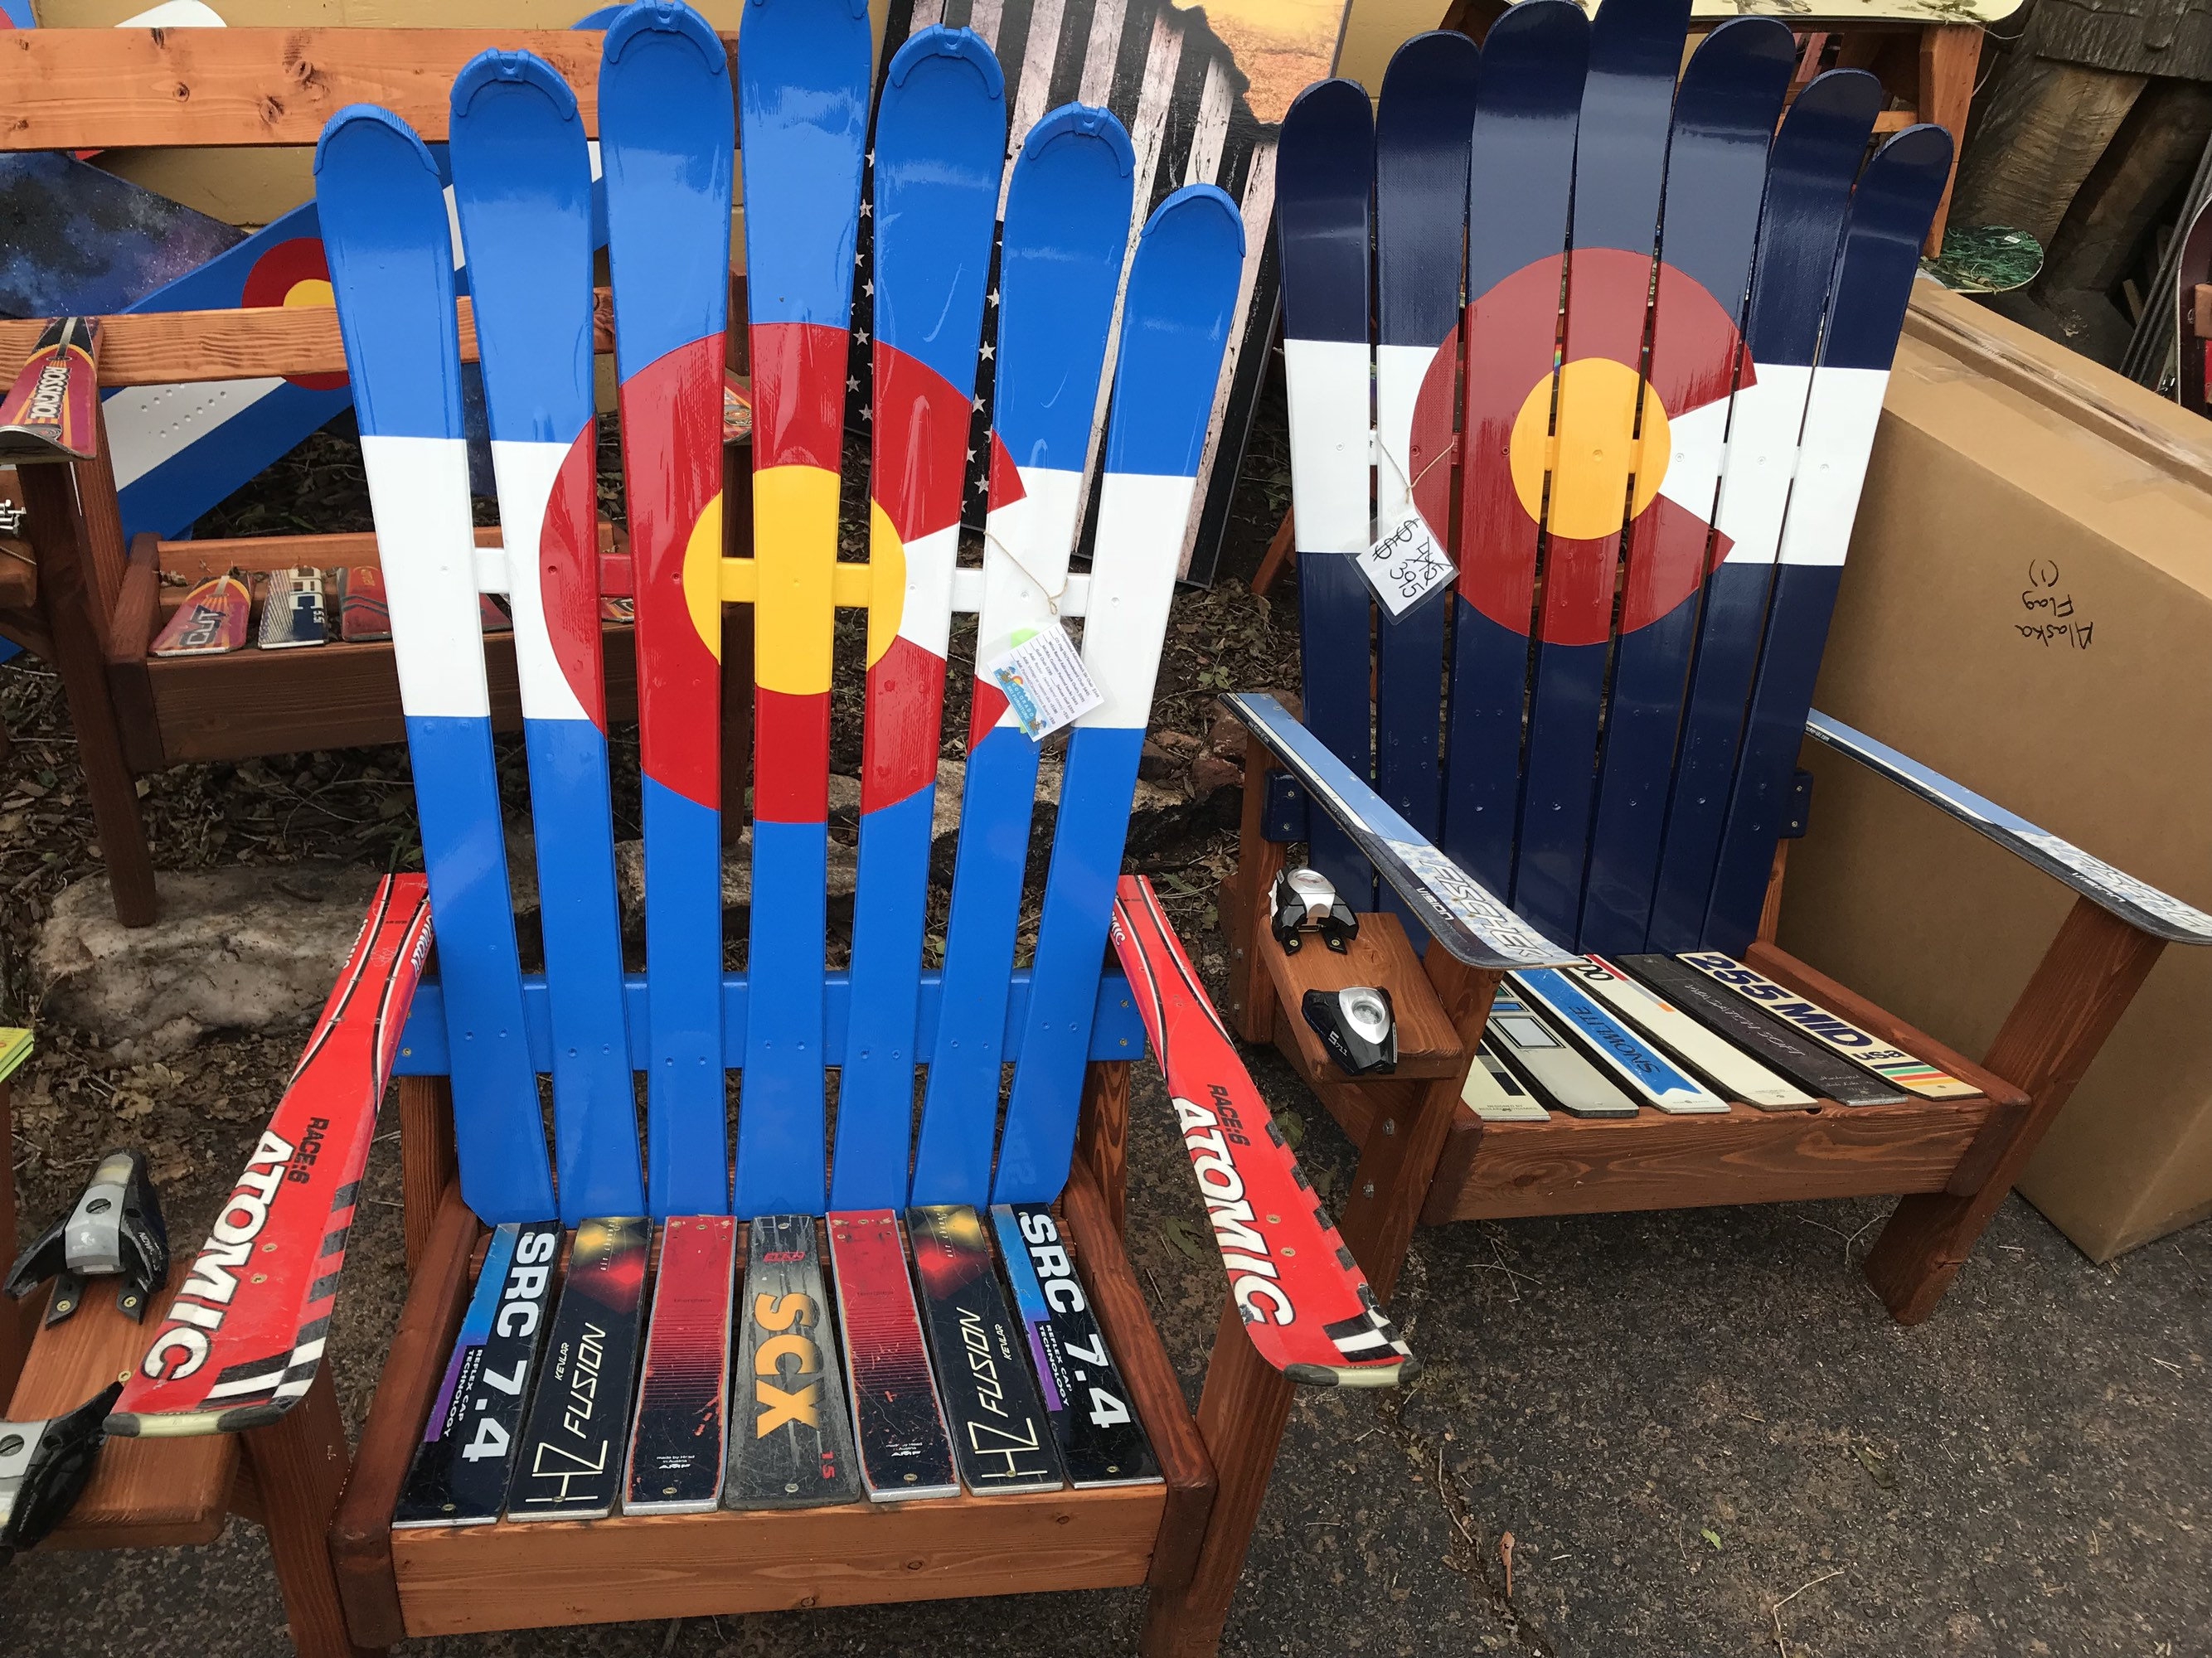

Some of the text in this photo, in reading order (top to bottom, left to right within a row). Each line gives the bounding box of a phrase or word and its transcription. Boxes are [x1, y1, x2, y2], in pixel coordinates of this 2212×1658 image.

[32, 366, 68, 419] ROSSIGNOL
[1390, 561, 1425, 598] 395
[2021, 590, 2074, 618] Flag
[182, 605, 224, 646] CUT
[2015, 621, 2093, 650] Alaska
[1006, 685, 1014, 694] SKI
[1011, 693, 1030, 720] FURNITURE
[1011, 682, 1034, 717] COLORADO
[1416, 887, 1455, 922] VISION
[1419, 860, 1554, 957] FISCHER
[2053, 847, 2212, 937] FISCHE
[1692, 955, 1874, 1048] 255 MID
[1570, 1006, 1661, 1074] SNOWLITE
[1855, 1050, 1907, 1062] usa
[1206, 1083, 1251, 1148] RACE:6
[287, 1116, 330, 1185] RACE:6
[1171, 1096, 1296, 1327] ATOMIC
[141, 1129, 296, 1381] ATOMIC
[462, 1232, 555, 1462] SRC 7.4
[994, 1323, 1013, 1361] KEVLAR
[1020, 1214, 1131, 1428] SRC 7.4
[458, 1349, 483, 1422] REFLEX CAP
[554, 1341, 570, 1382] KEVLAR
[563, 1321, 608, 1440] FUSION
[754, 1292, 824, 1439] SCX
[956, 1307, 1008, 1418] FUSION
[1039, 1325, 1070, 1407] TECHNOLOGY
[1045, 1324, 1073, 1392] REFLEX CAP
[444, 1349, 475, 1437] TECHNOLOGY
